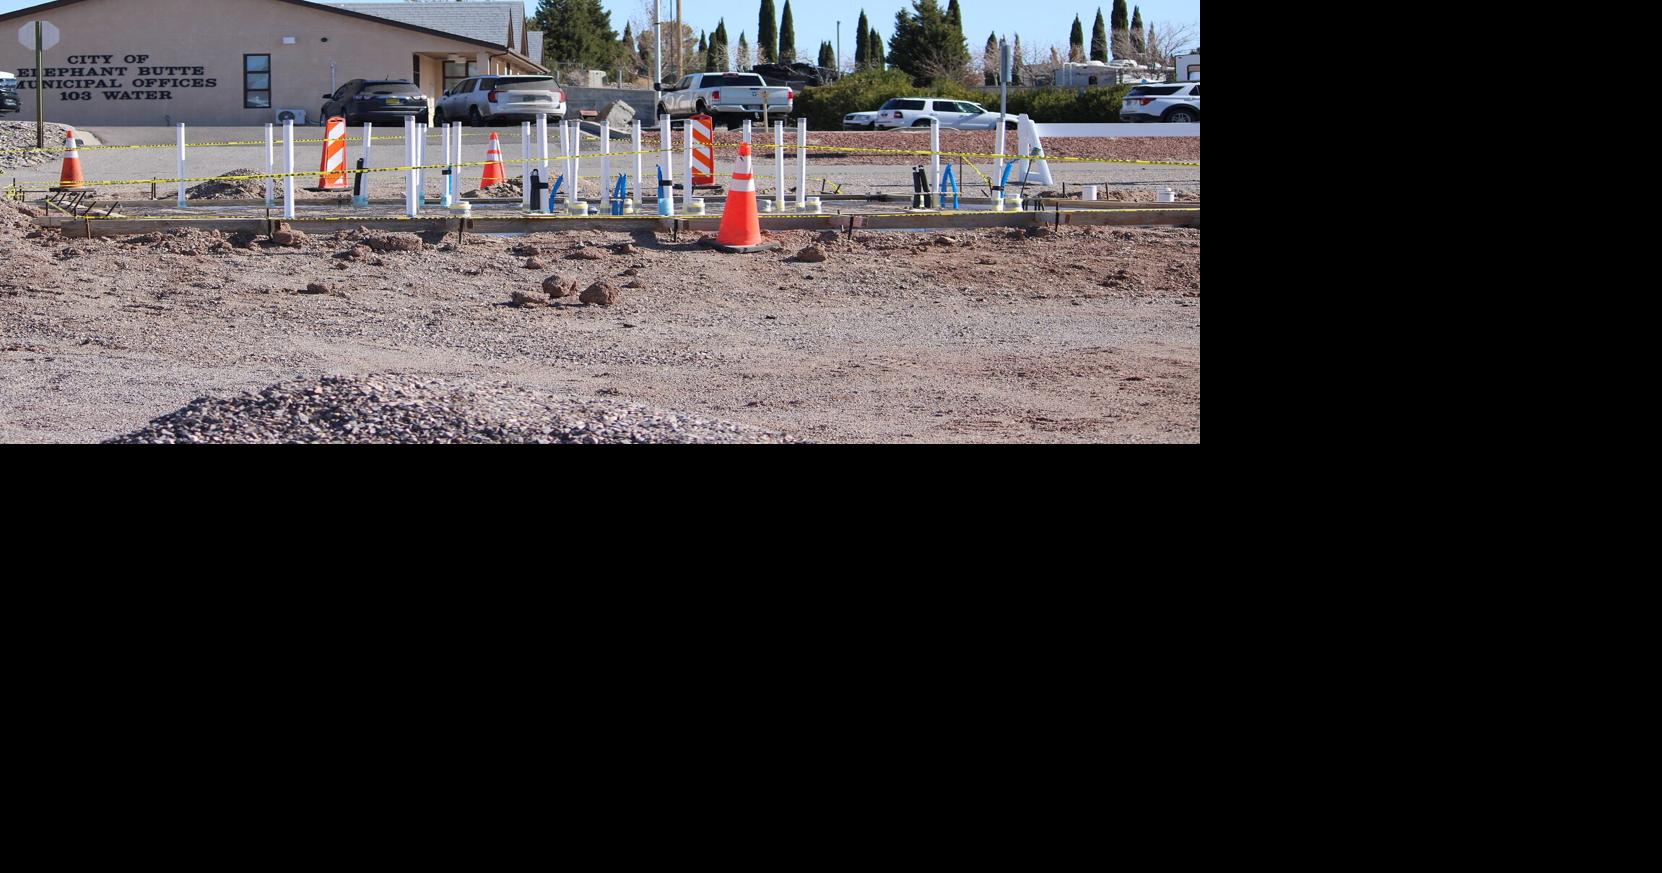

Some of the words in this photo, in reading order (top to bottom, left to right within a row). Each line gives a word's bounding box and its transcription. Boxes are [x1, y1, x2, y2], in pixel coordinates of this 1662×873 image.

[67, 54, 113, 65] CITY
[123, 54, 149, 64] OF
[16, 67, 128, 78] ELEPHANT
[137, 66, 204, 76] BUTTE
[132, 78, 217, 88] OFFICES
[60, 91, 92, 101] 103
[101, 90, 173, 100] WATER
